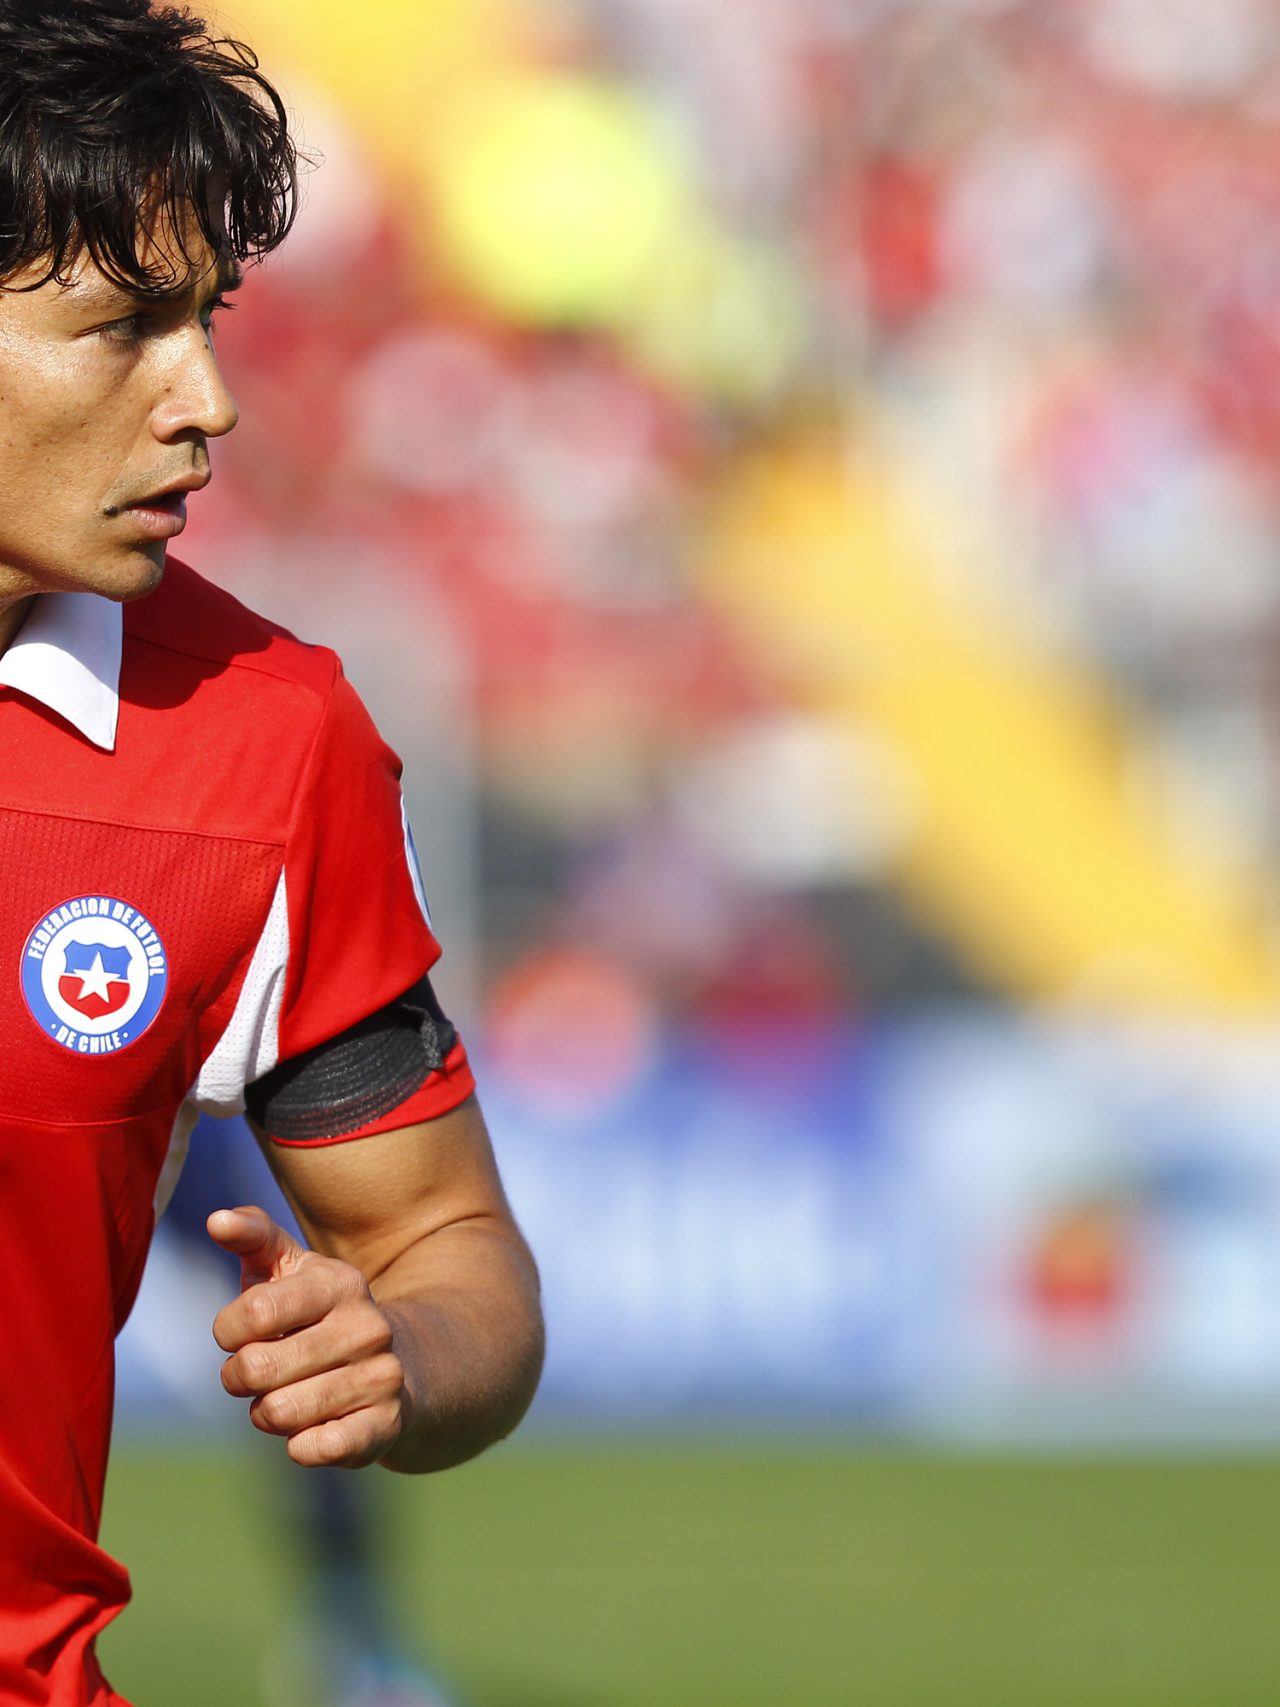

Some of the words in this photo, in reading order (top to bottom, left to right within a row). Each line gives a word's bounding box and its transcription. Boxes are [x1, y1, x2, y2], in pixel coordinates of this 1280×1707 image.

[28, 898, 110, 960] FEDERACION
[112, 902, 135, 923] DE
[131, 915, 166, 977] FUTBOL
[55, 1025, 77, 1048] DE
[78, 1032, 122, 1053] CHILE
